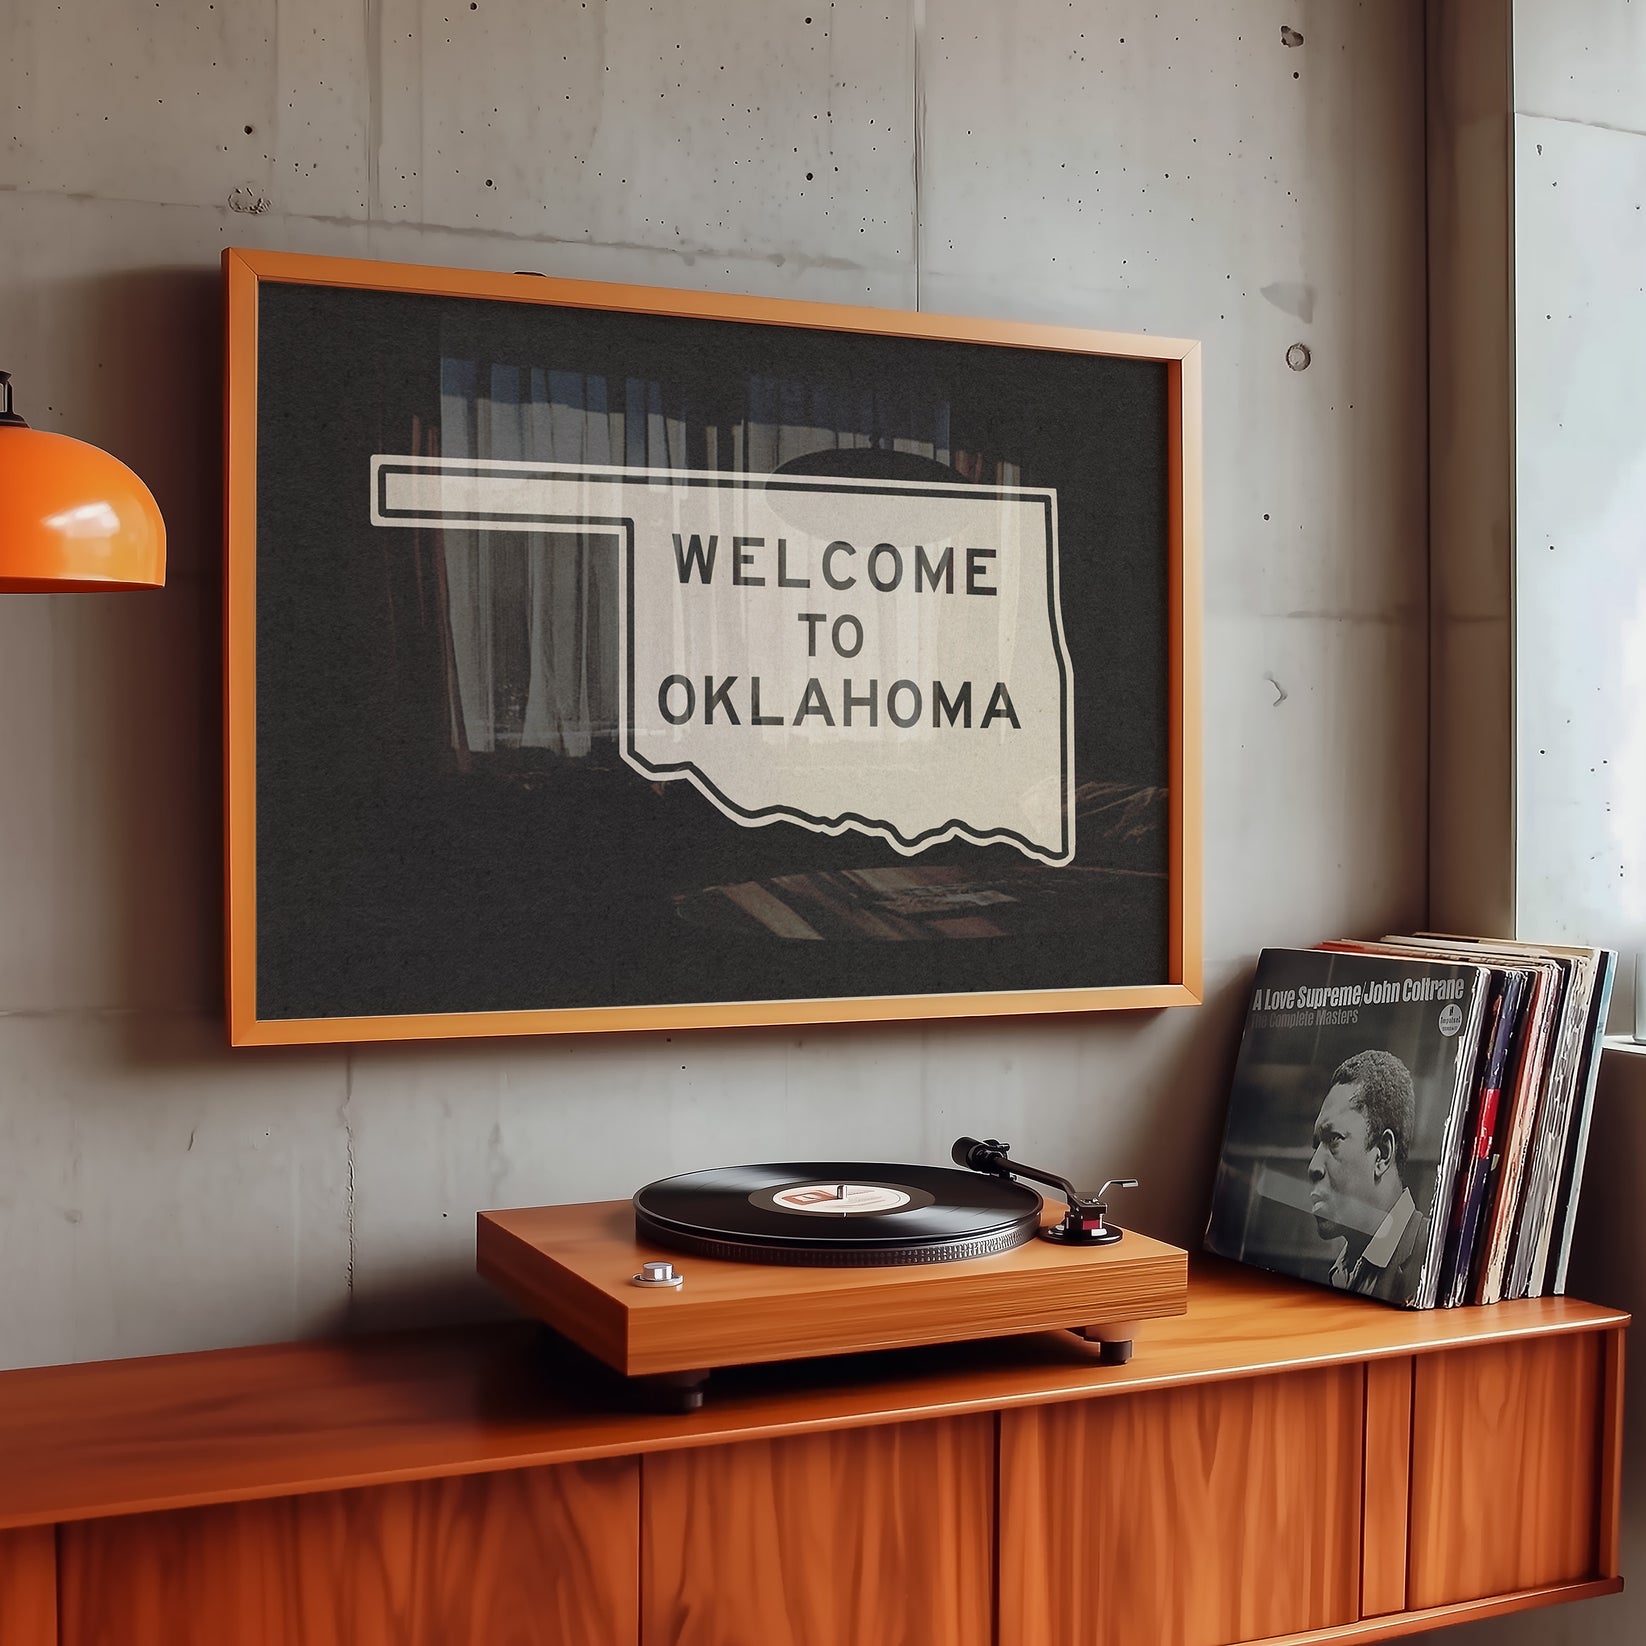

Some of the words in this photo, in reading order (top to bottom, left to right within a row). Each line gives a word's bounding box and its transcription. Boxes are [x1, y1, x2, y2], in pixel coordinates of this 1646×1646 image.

[672, 533, 998, 596] WELCOME
[798, 613, 864, 658] TO
[658, 674, 1022, 729] OKLAHOMA
[1252, 989, 1263, 1011] A
[1264, 988, 1296, 1011] Love
[1402, 977, 1465, 1002] Coltrane
[1269, 1010, 1314, 1029] Complete
[1315, 1008, 1359, 1026] Masters
